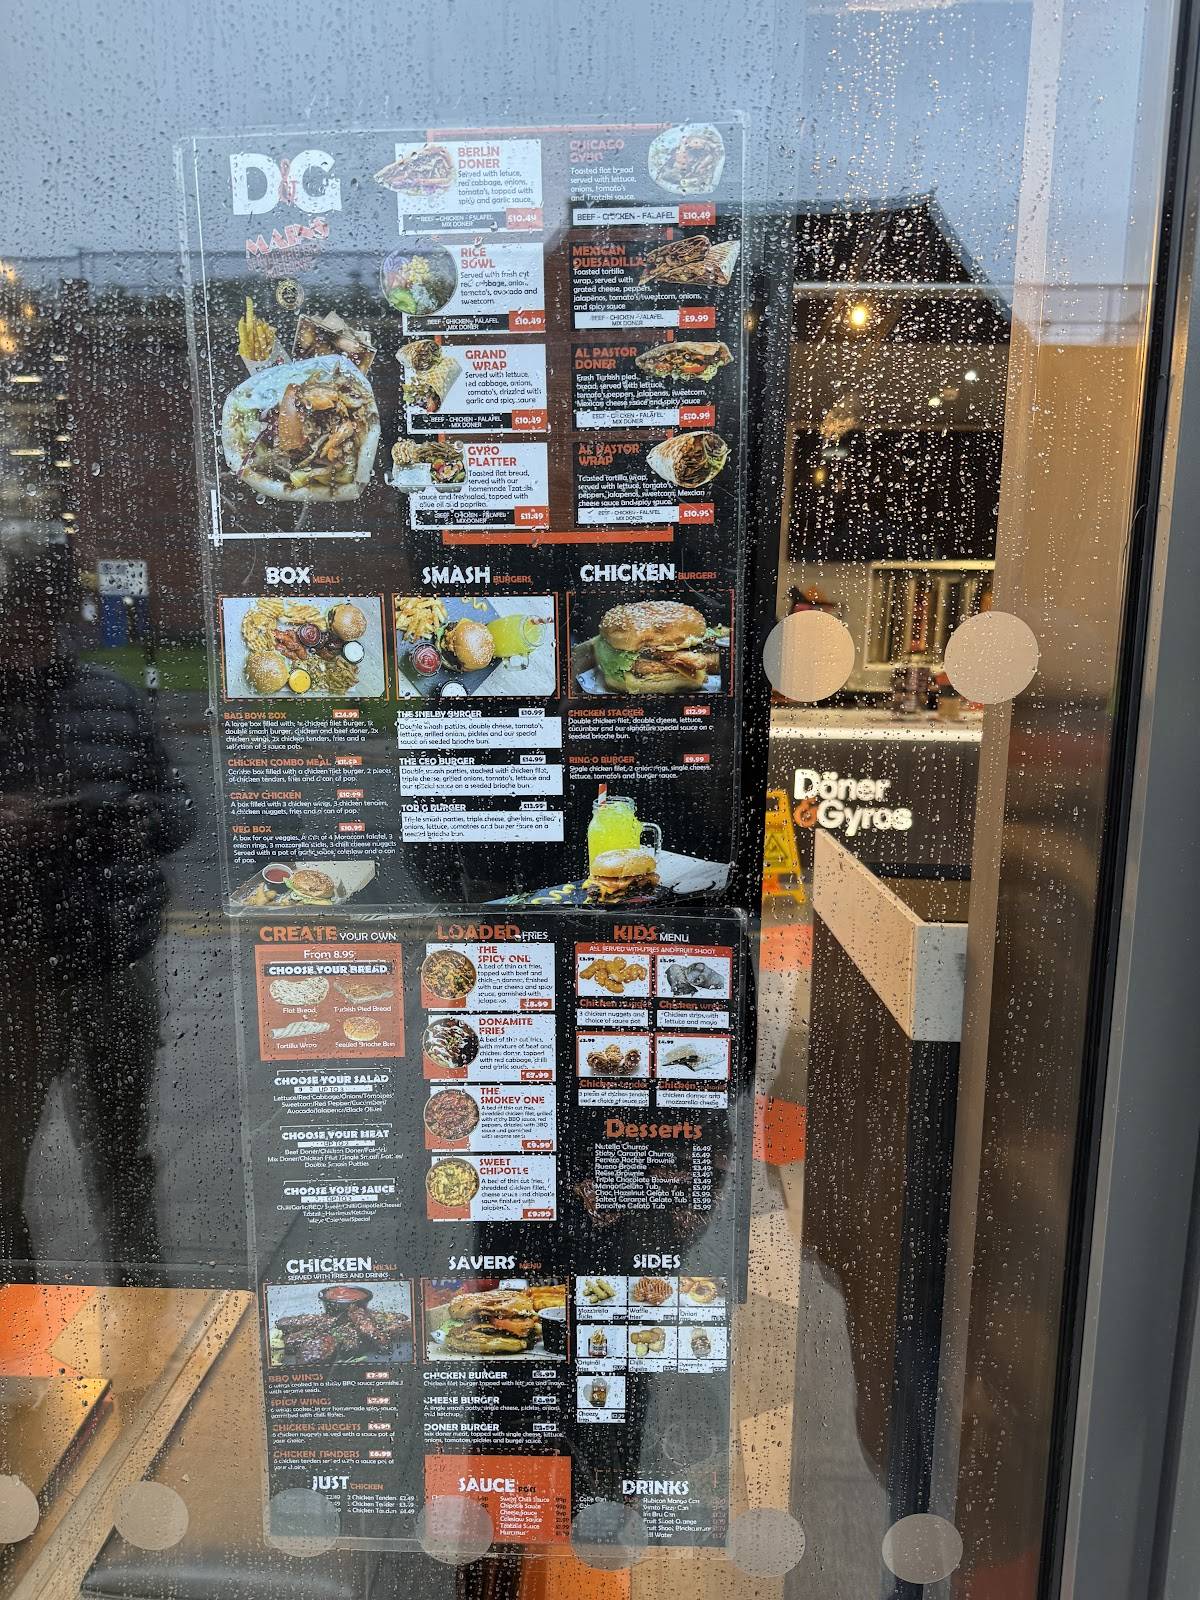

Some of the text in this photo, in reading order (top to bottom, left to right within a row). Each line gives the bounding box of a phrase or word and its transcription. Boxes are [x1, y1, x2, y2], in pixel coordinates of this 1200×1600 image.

[458, 146, 500, 157] BERLIN
[458, 158, 500, 169] DONER
[683, 212, 711, 220] £10.49
[460, 248, 487, 257] RICE
[461, 259, 496, 269] BOWL
[572, 257, 645, 268] QUESADILLA
[465, 350, 507, 359] GRAND
[575, 347, 637, 358] AL PASTOR
[472, 361, 507, 371] WRAP
[575, 359, 617, 370] DONER
[468, 446, 499, 456] GYRO
[468, 457, 517, 467] PLATTER
[578, 456, 613, 466] WRAP
[266, 566, 310, 585] BOX
[422, 566, 533, 584] SMASH BURGERS
[580, 563, 717, 582] CHICKEN BURGERS
[568, 709, 606, 717] CHICKEN
[228, 759, 268, 767] CHICKEN
[439, 757, 475, 765] BURGER
[600, 756, 635, 764] BURGER
[794, 768, 891, 801] Döner
[230, 792, 302, 800] CRAZY CHICKEN
[252, 825, 272, 833] BOX
[259, 926, 397, 942] CREATE YOUR OWN
[436, 924, 548, 940] LOADED FRIES
[613, 925, 689, 942] KIDS MENU
[303, 950, 331, 959] From
[478, 946, 498, 954] THE
[268, 965, 388, 975] CHOOSE YOUR BREAD
[478, 1018, 533, 1026] DONAMITE
[479, 1027, 505, 1035] FRIES
[274, 1074, 389, 1086] CHOOSE YOUR SALAD
[480, 1087, 500, 1095] THE
[480, 1096, 545, 1104] SMOKEY ONE
[605, 1119, 703, 1139] Desserts
[281, 1130, 390, 1140] CHOOSE YOUR MEAT
[479, 1158, 511, 1166] SWEET
[480, 1167, 529, 1175] CHIPOTLE
[284, 1185, 395, 1196] CHOOSE YOUR SAUCE
[286, 1257, 372, 1274] CHICKEN
[448, 1255, 515, 1270] SAVERS
[633, 1255, 680, 1269] SIDES
[291, 1373, 324, 1381] WINGS
[272, 1423, 315, 1432] CHICKEN
[424, 1423, 500, 1431] DONER BURGER
[273, 1450, 316, 1458] CHICKEN
[312, 1476, 350, 1490] JUST
[458, 1478, 515, 1492] SAUCE
[622, 1480, 689, 1495] DRINKS
